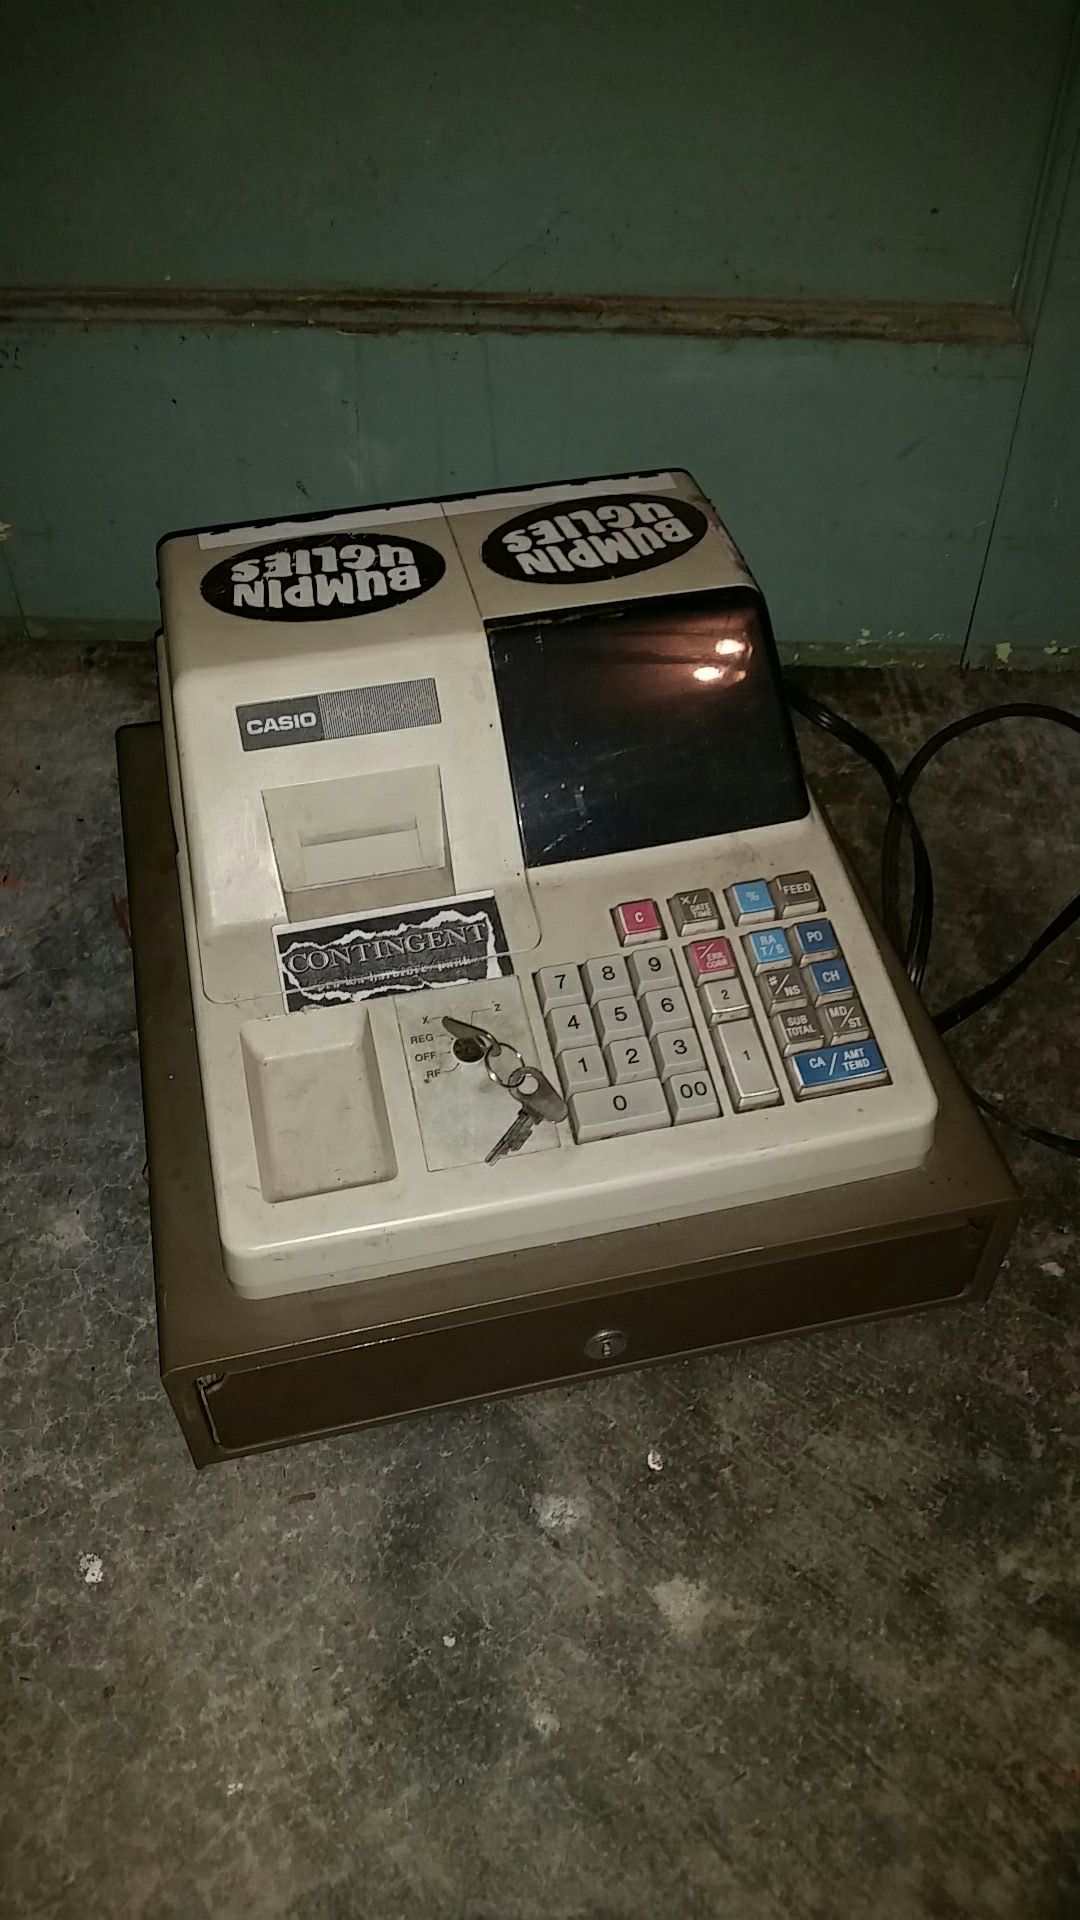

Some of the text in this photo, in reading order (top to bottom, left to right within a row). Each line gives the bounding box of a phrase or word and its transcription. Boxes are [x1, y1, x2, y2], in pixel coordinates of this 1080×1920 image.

[502, 502, 675, 553] UGLIES
[515, 518, 694, 575] BUMPIN
[231, 544, 415, 583] UGLIES
[233, 565, 421, 608] BUMPIN
[246, 712, 317, 735] CASIO
[783, 882, 811, 895] FEED
[634, 911, 645, 923] C
[759, 934, 776, 946] RA
[806, 930, 823, 943] PO
[288, 922, 487, 973] CONTINGENT
[759, 944, 784, 956] T/S
[648, 957, 662, 972] 9
[602, 966, 616, 981] 8
[822, 970, 840, 983] CH
[554, 974, 566, 989] 7
[721, 990, 730, 1000] 2
[661, 998, 675, 1013] 6
[422, 1015, 429, 1025] X
[614, 1006, 628, 1022] 5
[787, 1015, 809, 1026] SUB
[567, 1015, 580, 1030] 4
[786, 1024, 816, 1038] TOTAL
[410, 1033, 434, 1045] REG
[673, 1039, 687, 1055] 3
[414, 1052, 437, 1062] OFF
[625, 1048, 640, 1064] 2
[743, 1050, 752, 1061] 1
[809, 1057, 826, 1069] CA
[843, 1047, 865, 1060] AMT
[578, 1057, 588, 1073] 1
[841, 1059, 871, 1072] TEND
[426, 1069, 441, 1080] RF
[680, 1082, 707, 1099] 00
[613, 1095, 627, 1111] 0
